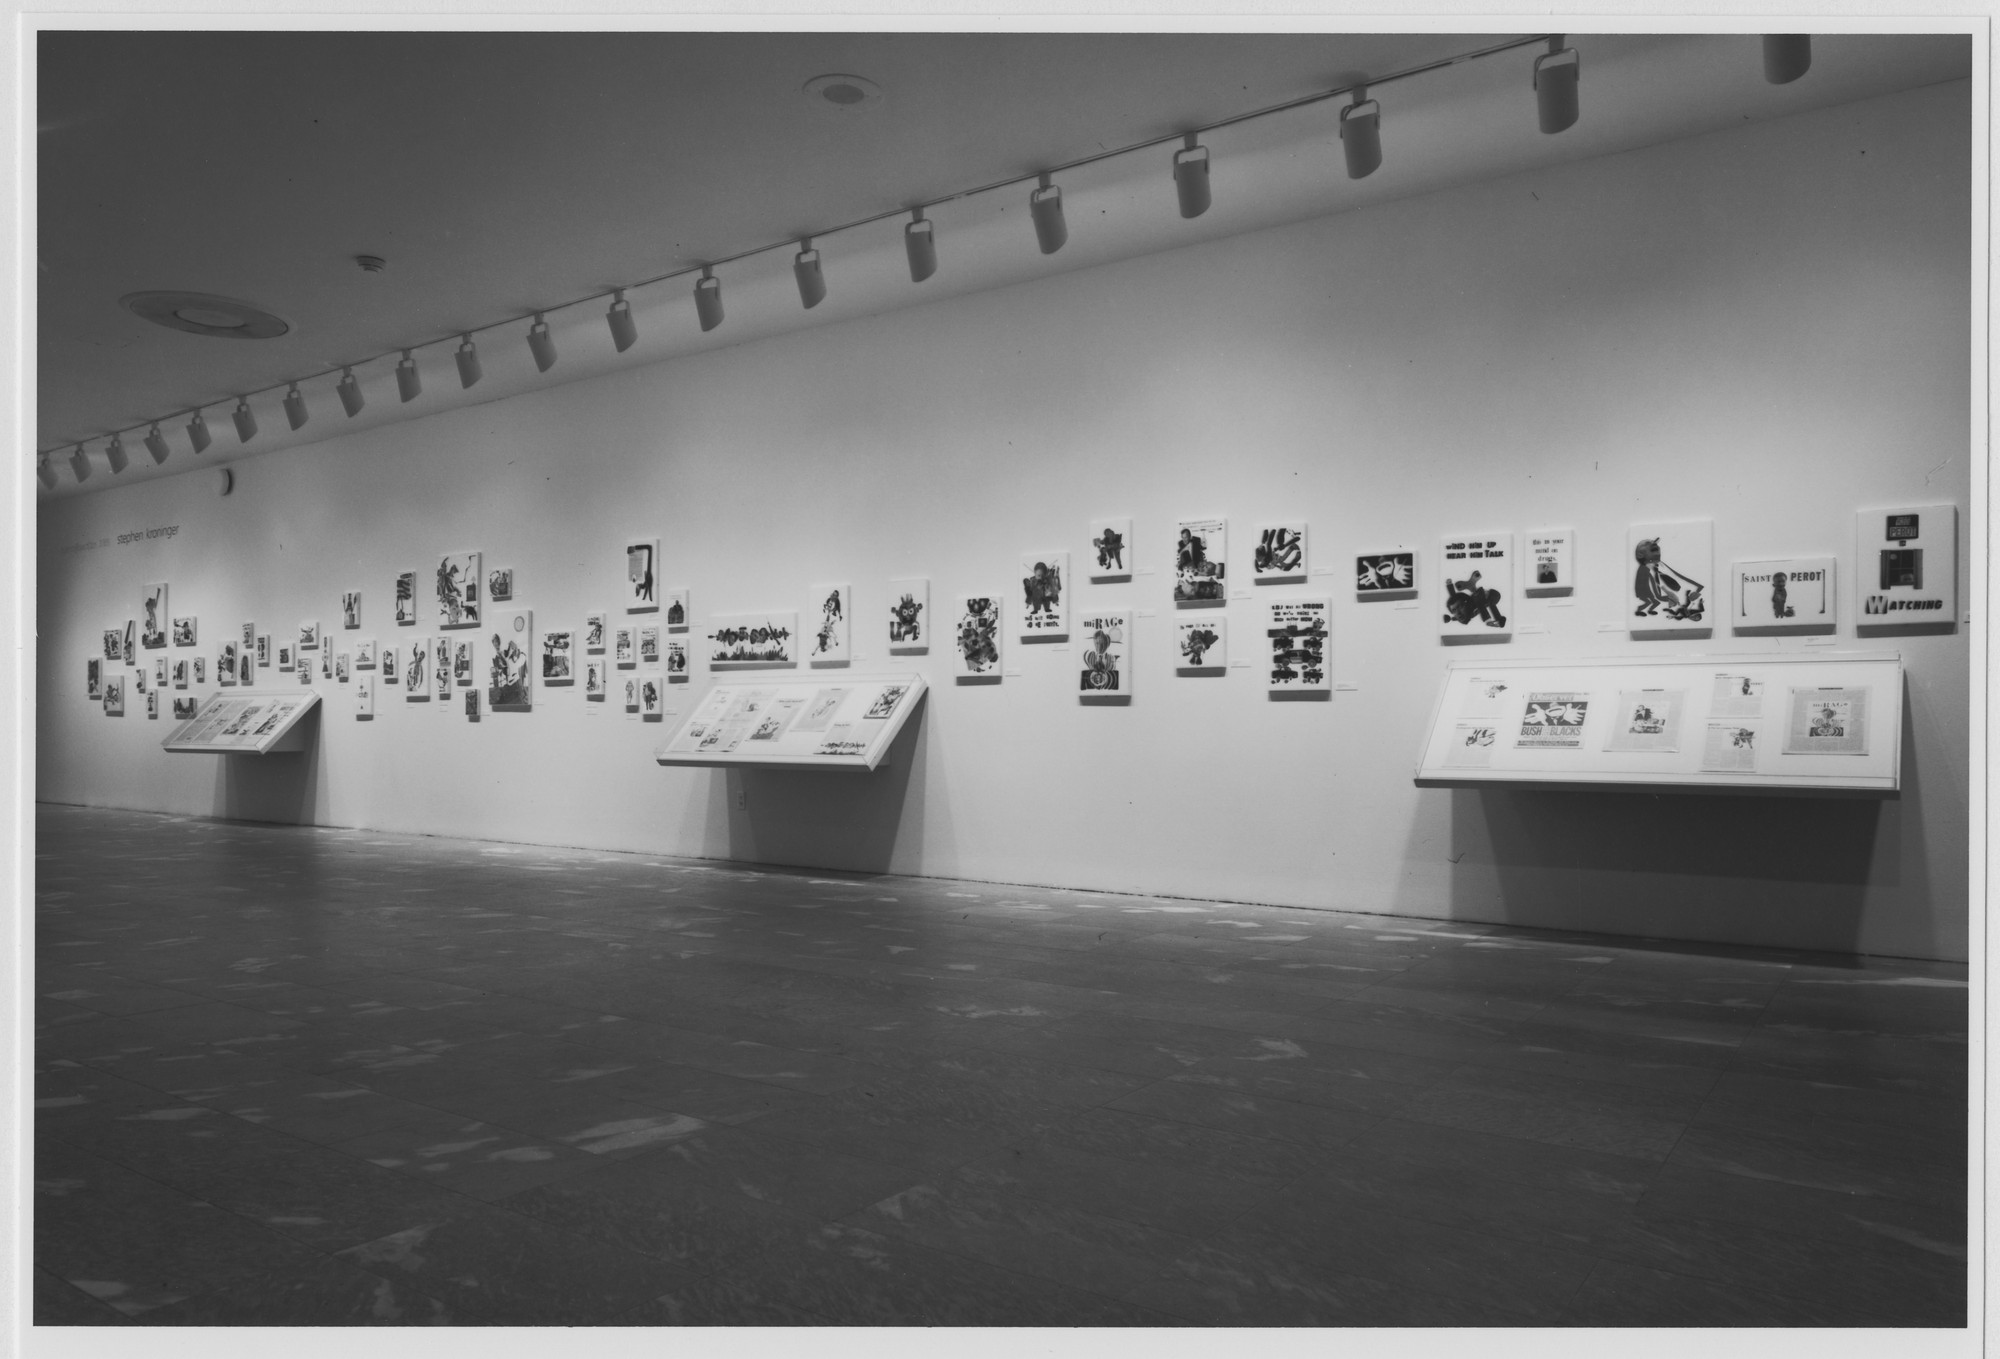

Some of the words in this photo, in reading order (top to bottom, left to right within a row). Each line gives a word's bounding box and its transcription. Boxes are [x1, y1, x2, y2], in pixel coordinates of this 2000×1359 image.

[117, 531, 144, 545] stephen
[146, 525, 179, 539] kroninger
[1744, 574, 1772, 583] SAINT
[1790, 571, 1822, 582] PEROT
[1520, 726, 1543, 736] BUSH
[1549, 726, 1582, 736] BLACKS
